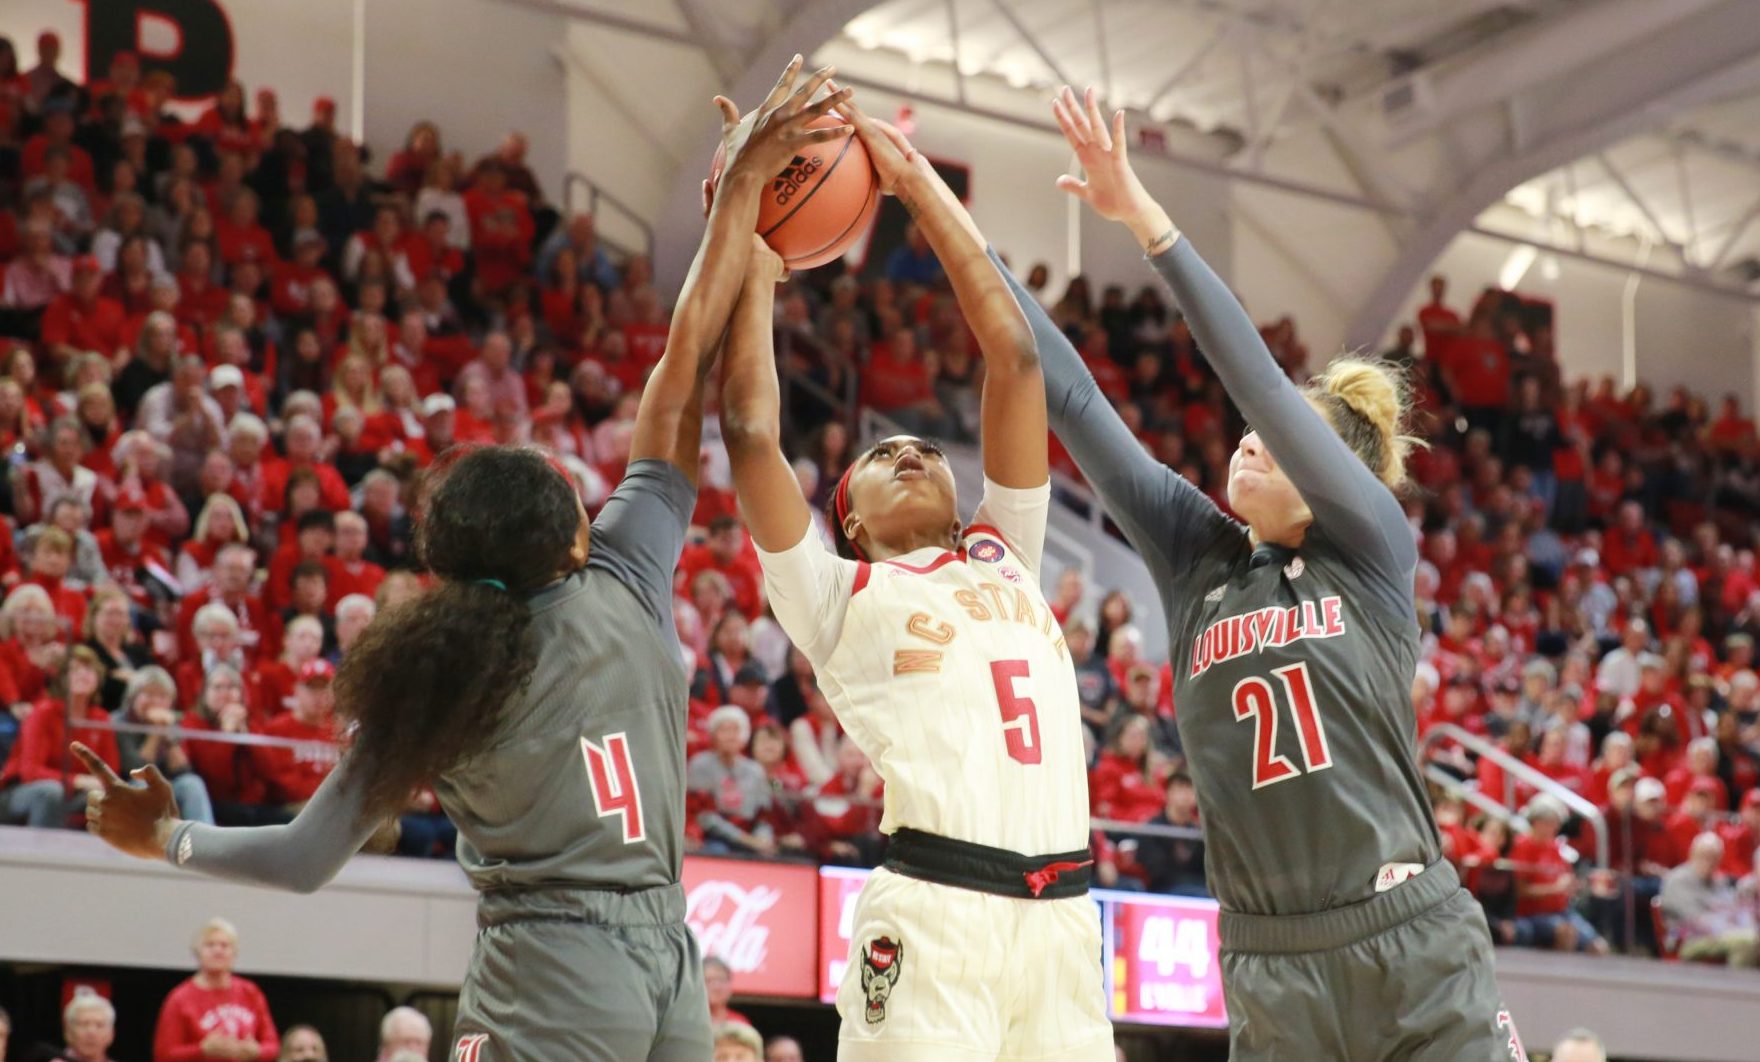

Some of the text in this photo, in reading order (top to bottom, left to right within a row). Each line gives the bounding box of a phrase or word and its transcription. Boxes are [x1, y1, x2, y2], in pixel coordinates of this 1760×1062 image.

[776, 156, 823, 205] adidas
[893, 611, 957, 677] NC
[1190, 596, 1345, 681] LOUISVILLE
[990, 659, 1042, 765] 5
[1231, 661, 1333, 790] 21
[580, 732, 646, 844] 4
